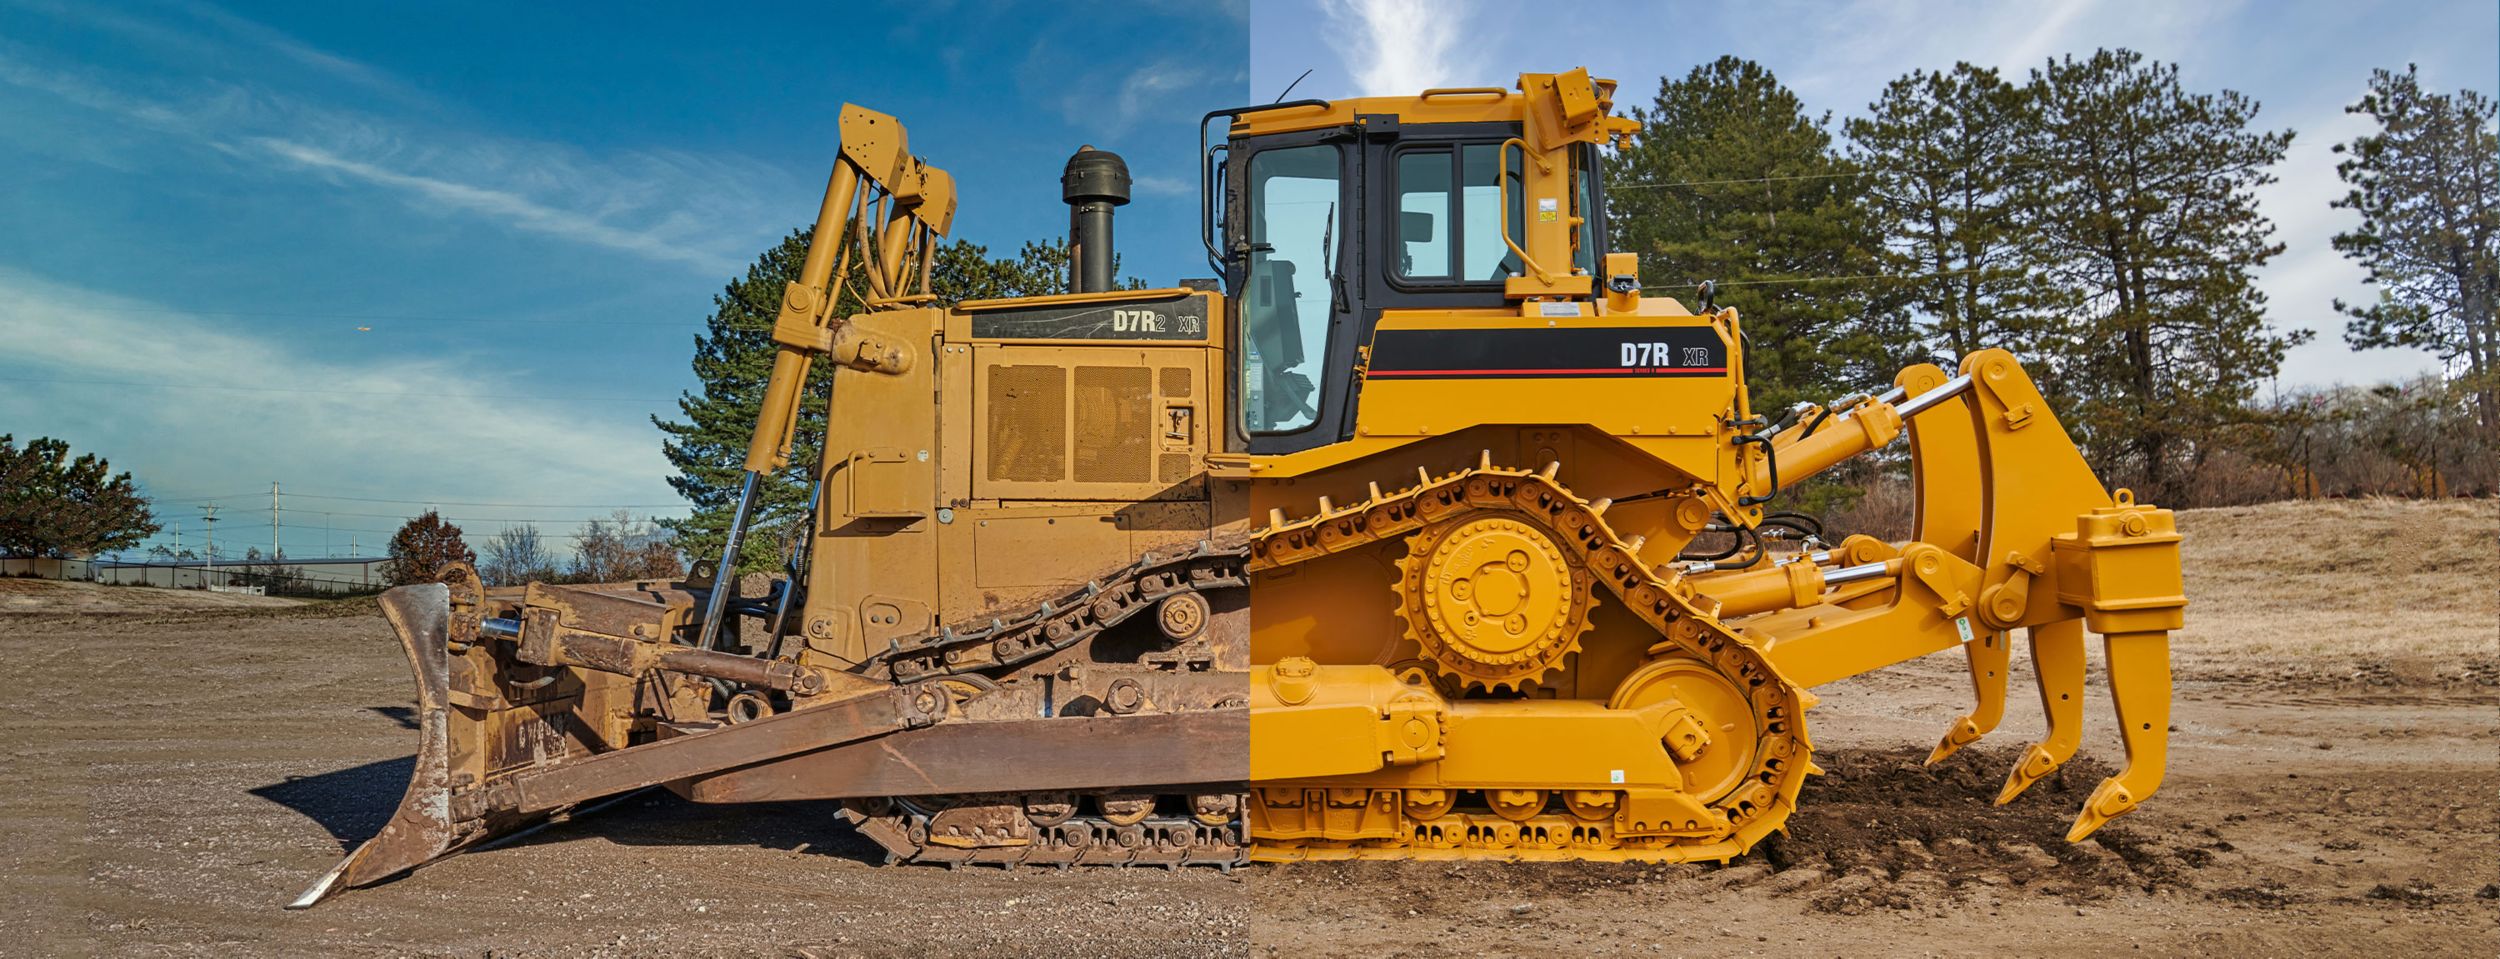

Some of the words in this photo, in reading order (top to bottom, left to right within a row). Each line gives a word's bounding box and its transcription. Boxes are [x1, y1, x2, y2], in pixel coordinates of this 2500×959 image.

[1178, 315, 1201, 333] XR
[1621, 342, 1669, 367] D7R
[1682, 347, 1709, 366] XR
